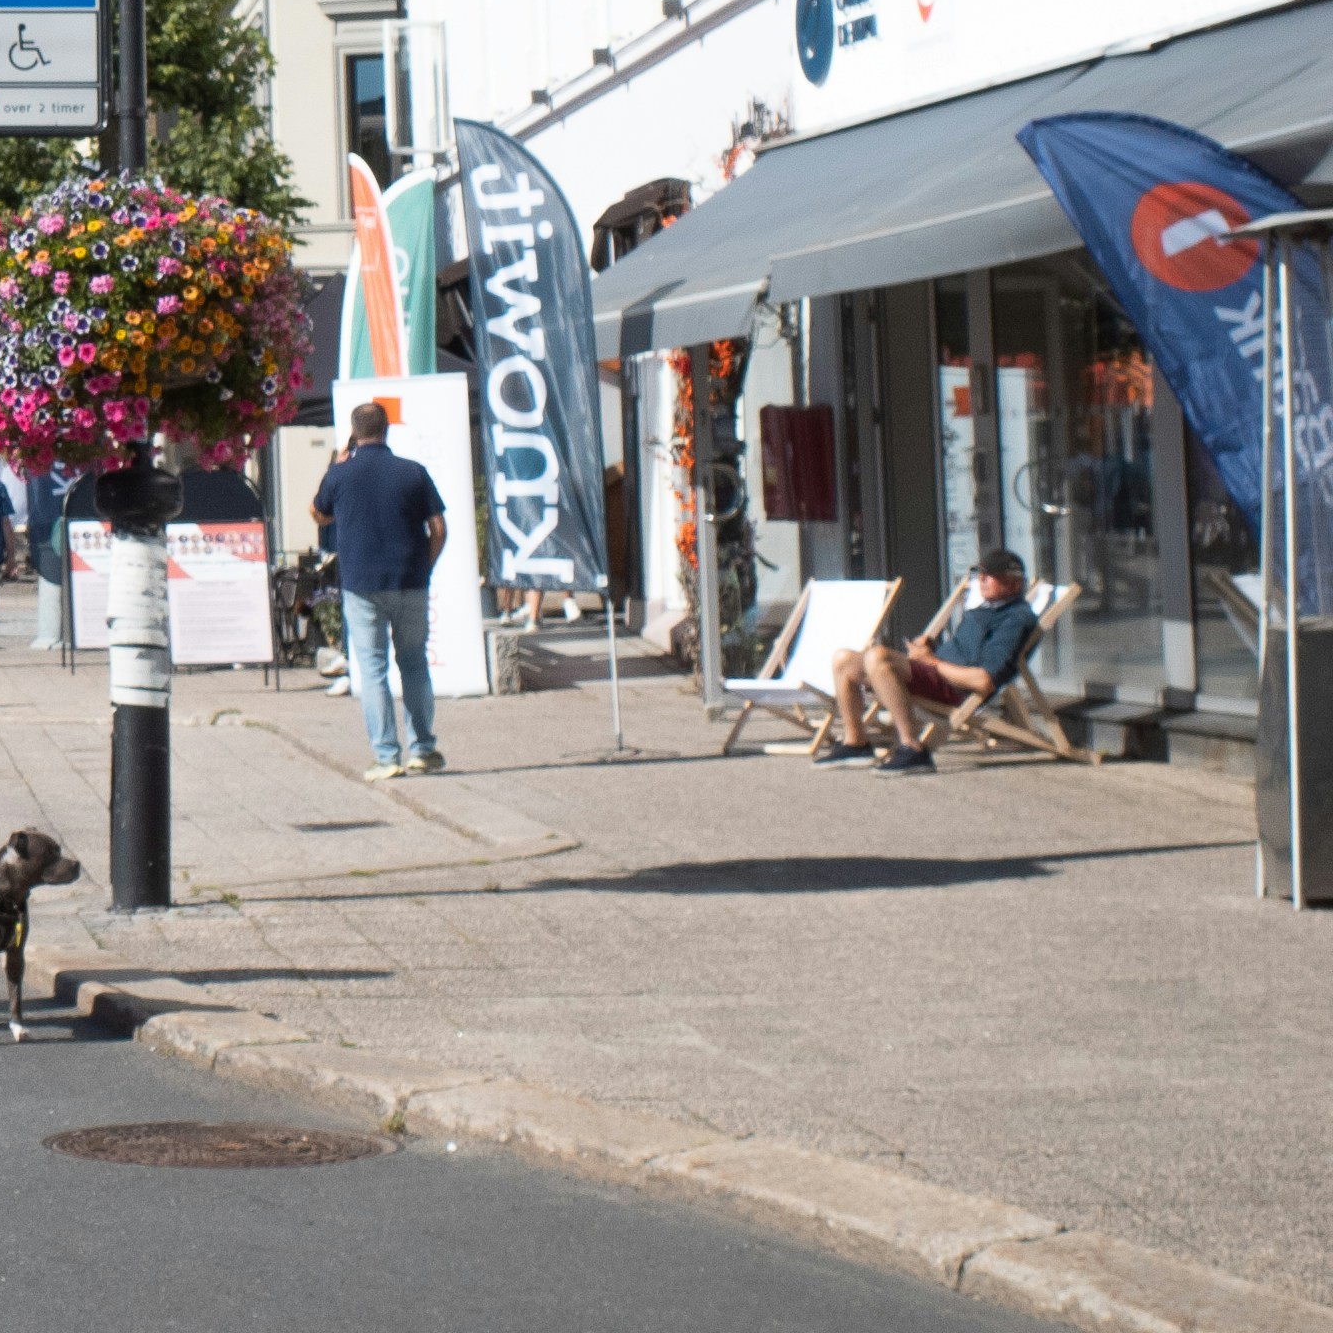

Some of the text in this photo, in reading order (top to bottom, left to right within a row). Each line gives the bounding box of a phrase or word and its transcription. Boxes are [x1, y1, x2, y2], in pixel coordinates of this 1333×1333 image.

[3, 102, 85, 113] over 2 timer
